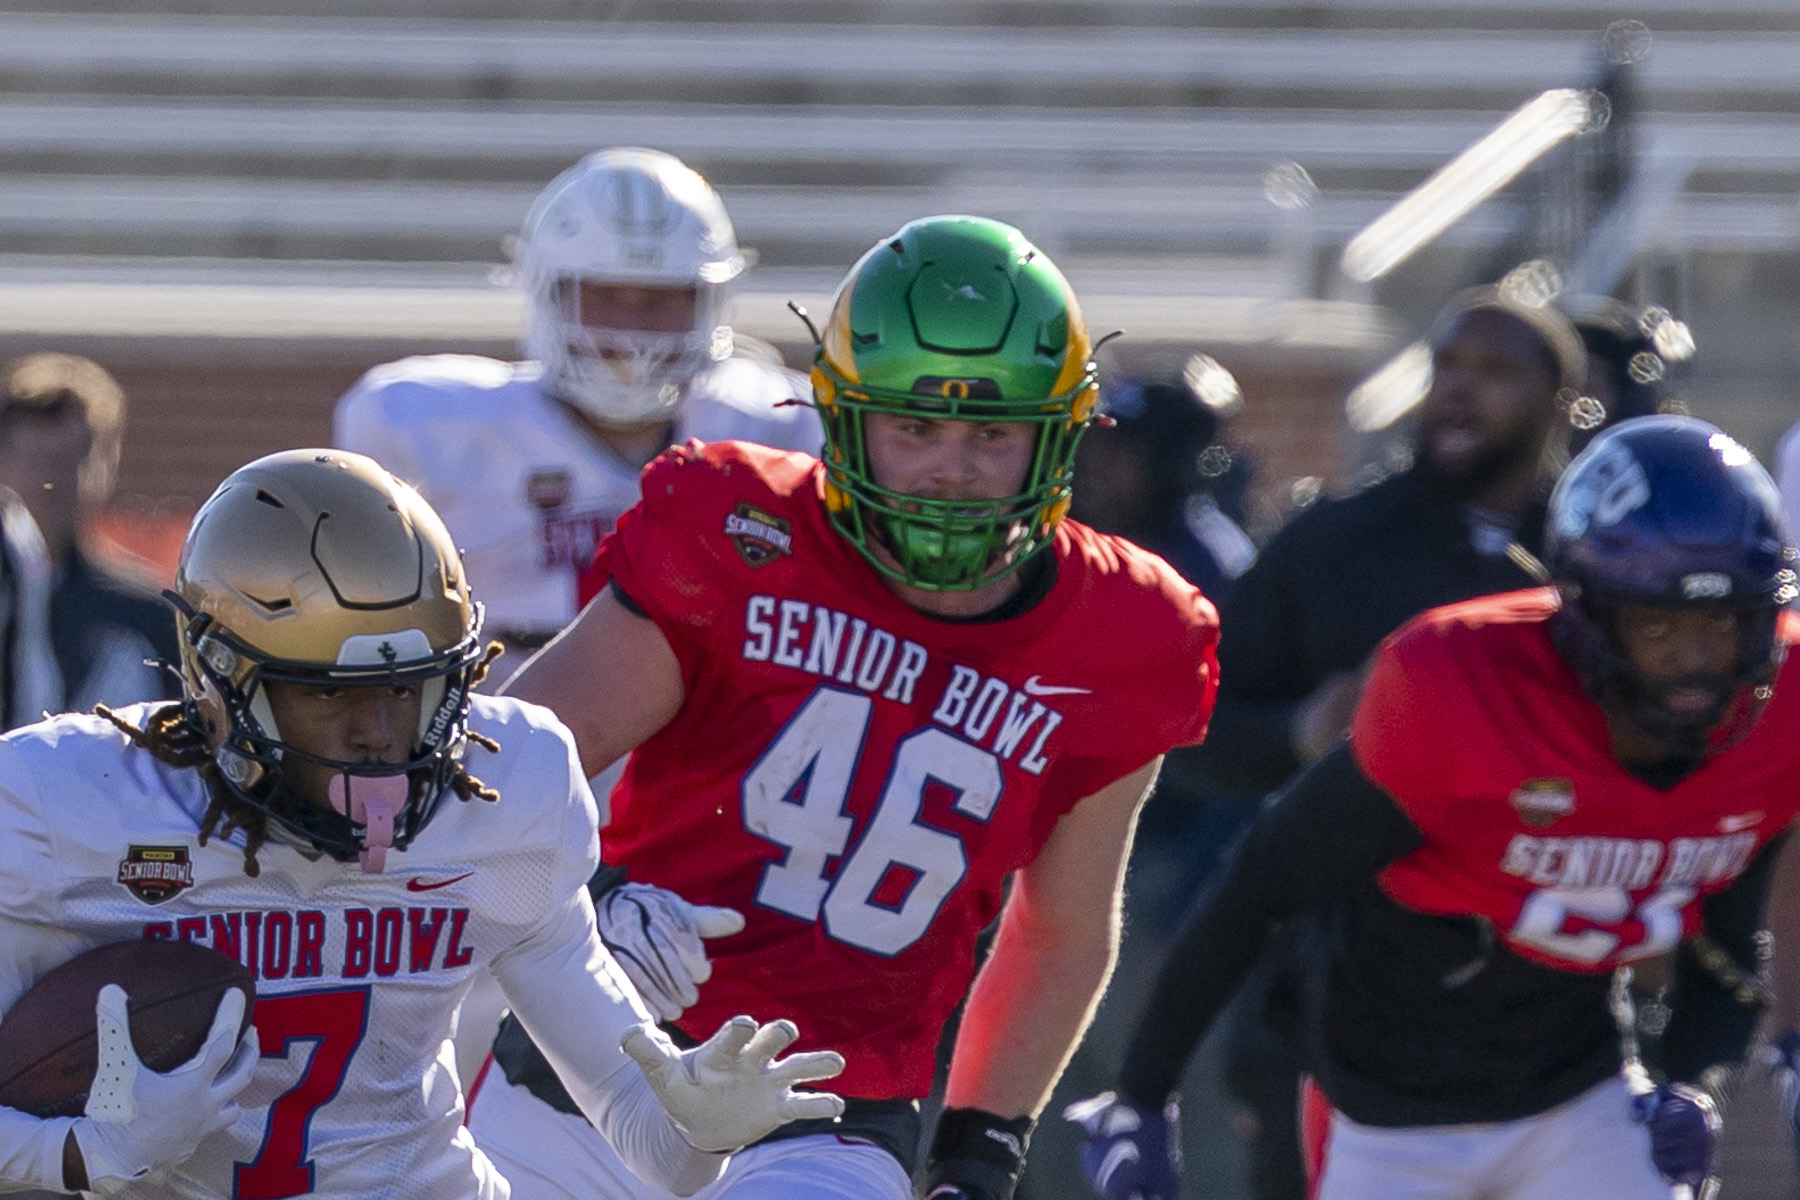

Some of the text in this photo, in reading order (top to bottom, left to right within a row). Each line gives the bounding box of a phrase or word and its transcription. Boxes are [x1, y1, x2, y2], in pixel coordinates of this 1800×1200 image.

[424, 687, 462, 747] Riddell
[743, 594, 1064, 776] SENIOR BOWL
[740, 682, 1006, 959] 46
[120, 861, 192, 884] SENIOR BOWL
[341, 907, 475, 979] BOWL
